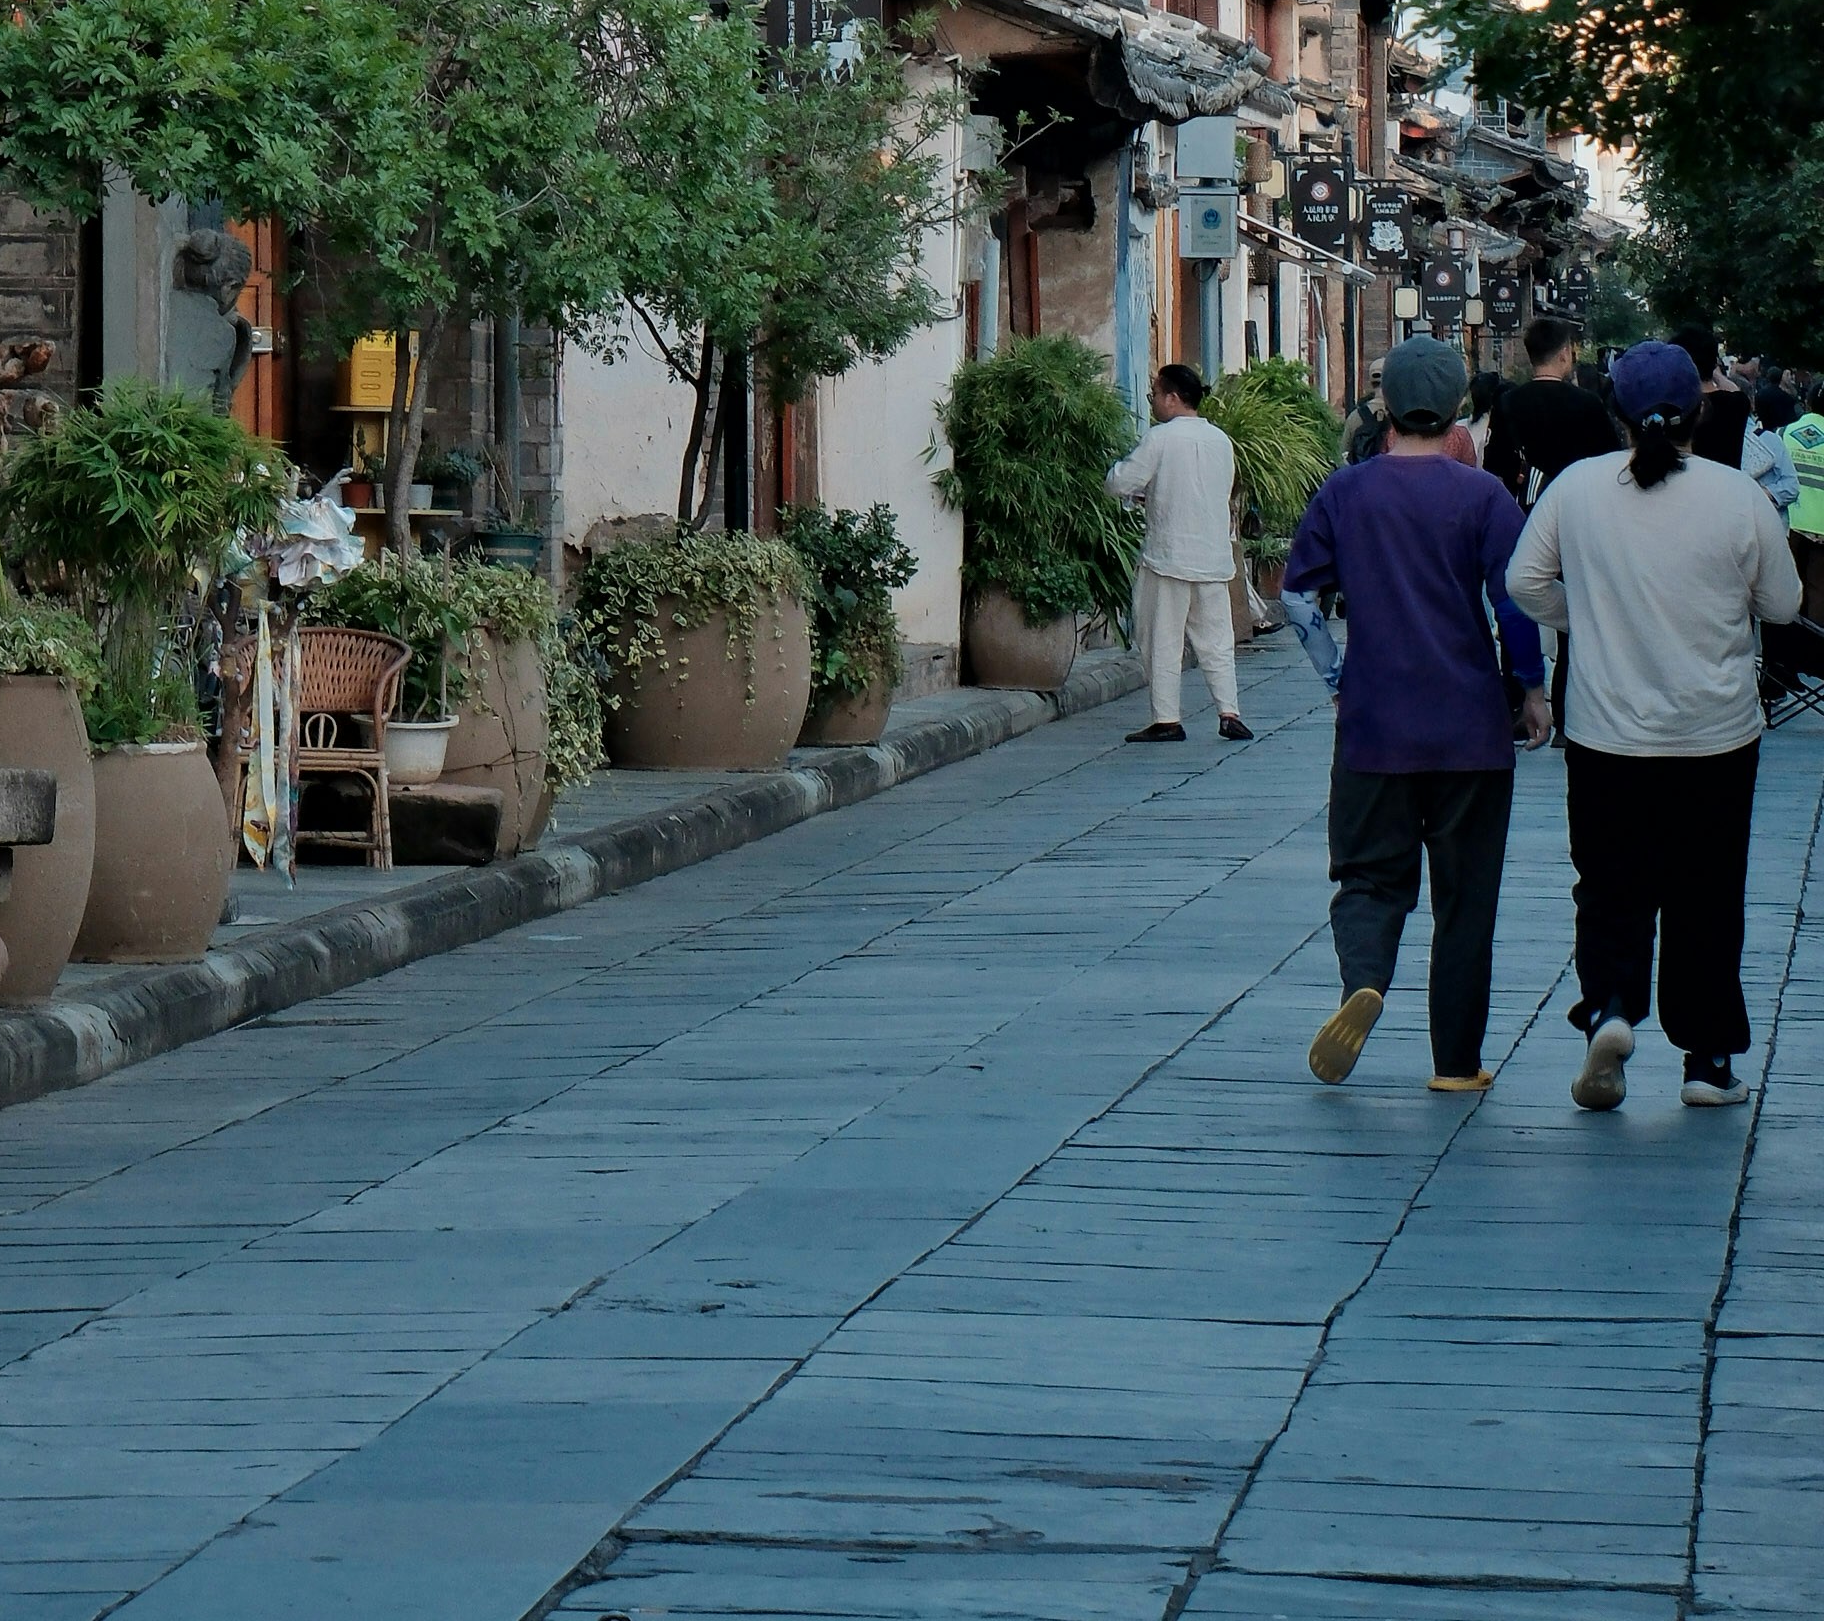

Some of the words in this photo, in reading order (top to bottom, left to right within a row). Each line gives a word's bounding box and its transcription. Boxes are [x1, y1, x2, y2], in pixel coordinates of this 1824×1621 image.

[1302, 205, 1339, 214] 人民的非遗
[1305, 213, 1336, 223] 人民共享
